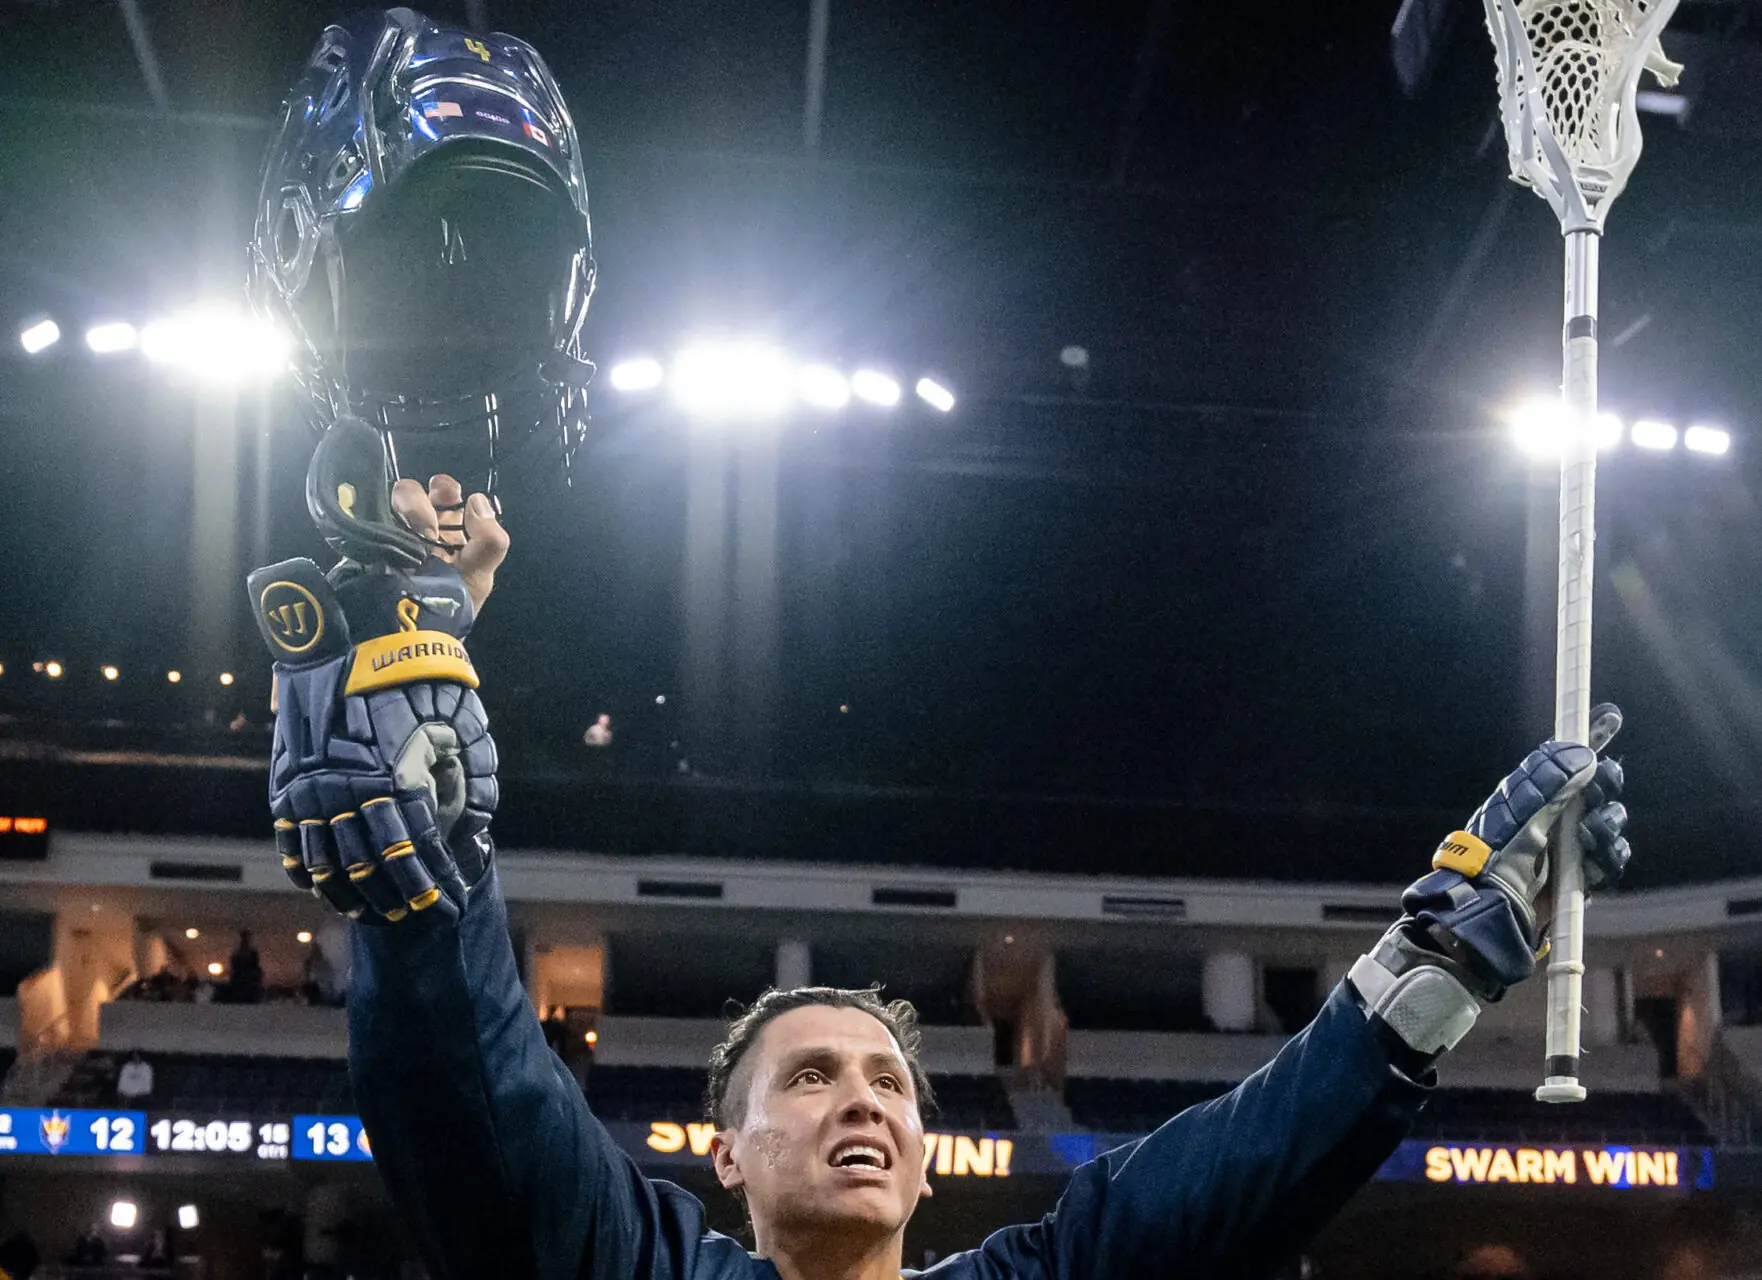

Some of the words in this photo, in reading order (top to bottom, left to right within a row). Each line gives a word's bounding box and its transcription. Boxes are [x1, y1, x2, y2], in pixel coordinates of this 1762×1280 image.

[464, 38, 491, 63] 4
[90, 1116, 135, 1150] 12
[150, 1119, 252, 1151] 12:05
[307, 1122, 350, 1155] 13
[1425, 1147, 1577, 1184] SWARM
[1583, 1150, 1678, 1185] WIN!
